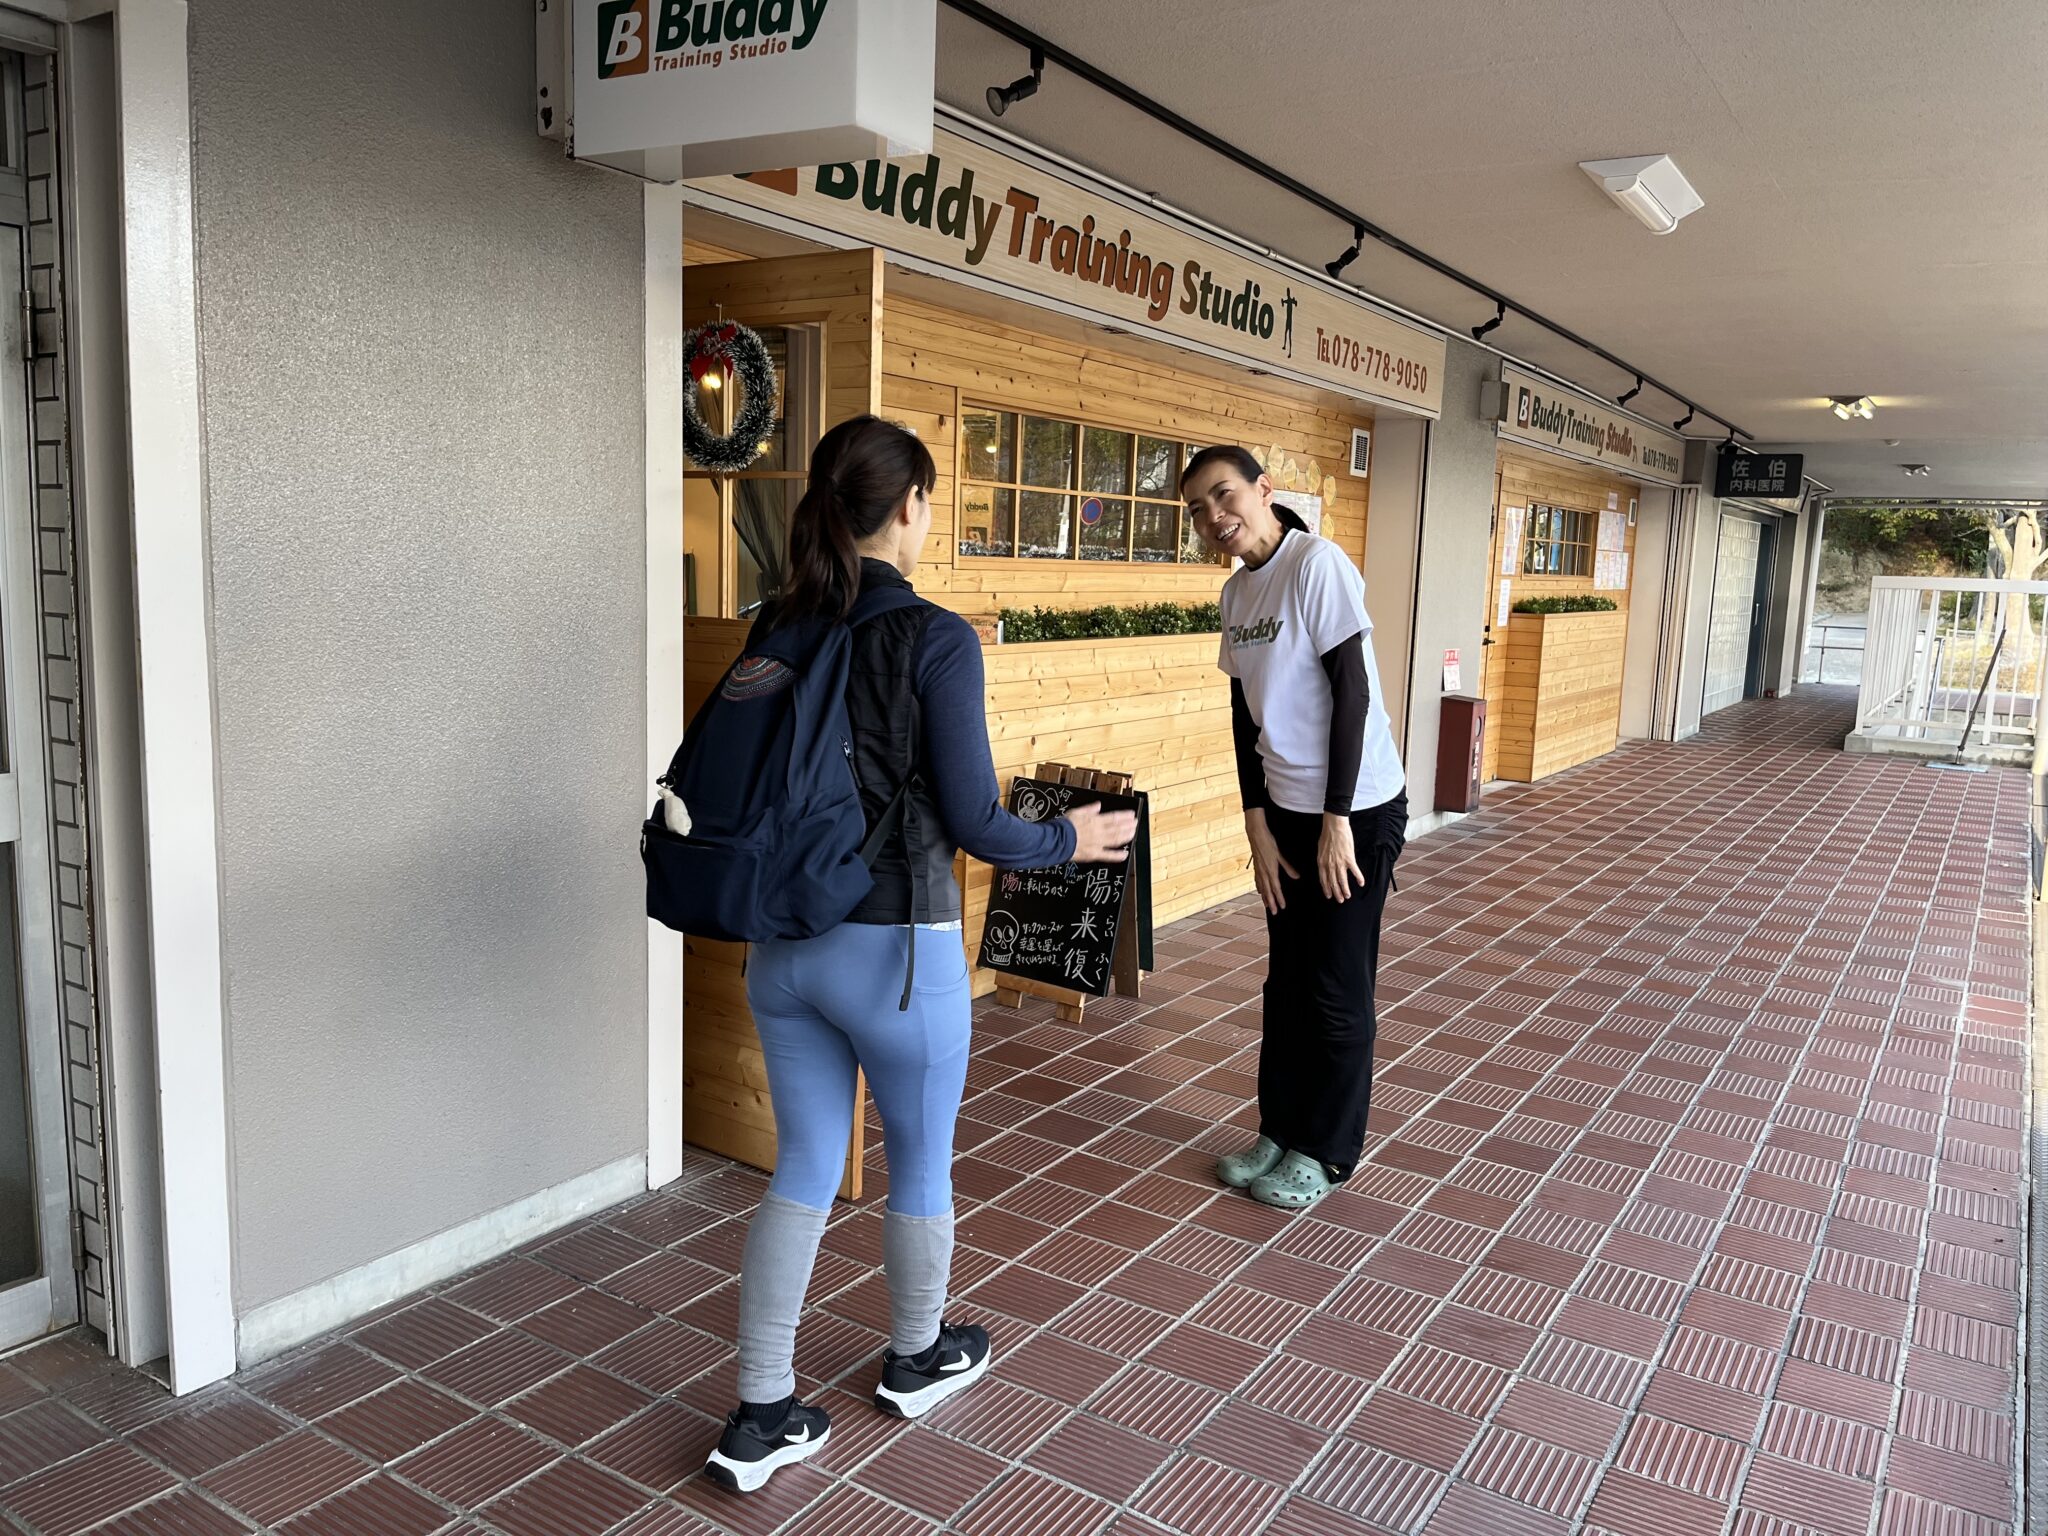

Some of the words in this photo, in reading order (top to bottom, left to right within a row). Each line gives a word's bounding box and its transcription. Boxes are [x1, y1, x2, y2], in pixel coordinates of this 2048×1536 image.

[605, 11, 642, 65] B
[656, 0, 828, 52] Buddy
[654, 50, 722, 71] Training
[730, 38, 787, 60] Studio
[815, 154, 1003, 265] Buddy
[1006, 186, 1174, 321] Training
[1179, 260, 1275, 339] Studio
[1332, 334, 1427, 394] 078-778-9050
[1530, 395, 1568, 444] Buddy
[1565, 408, 1605, 456] Training
[1605, 422, 1632, 457] Studio
[1729, 479, 1785, 492] 内科医院
[1233, 616, 1284, 644] Buddy
